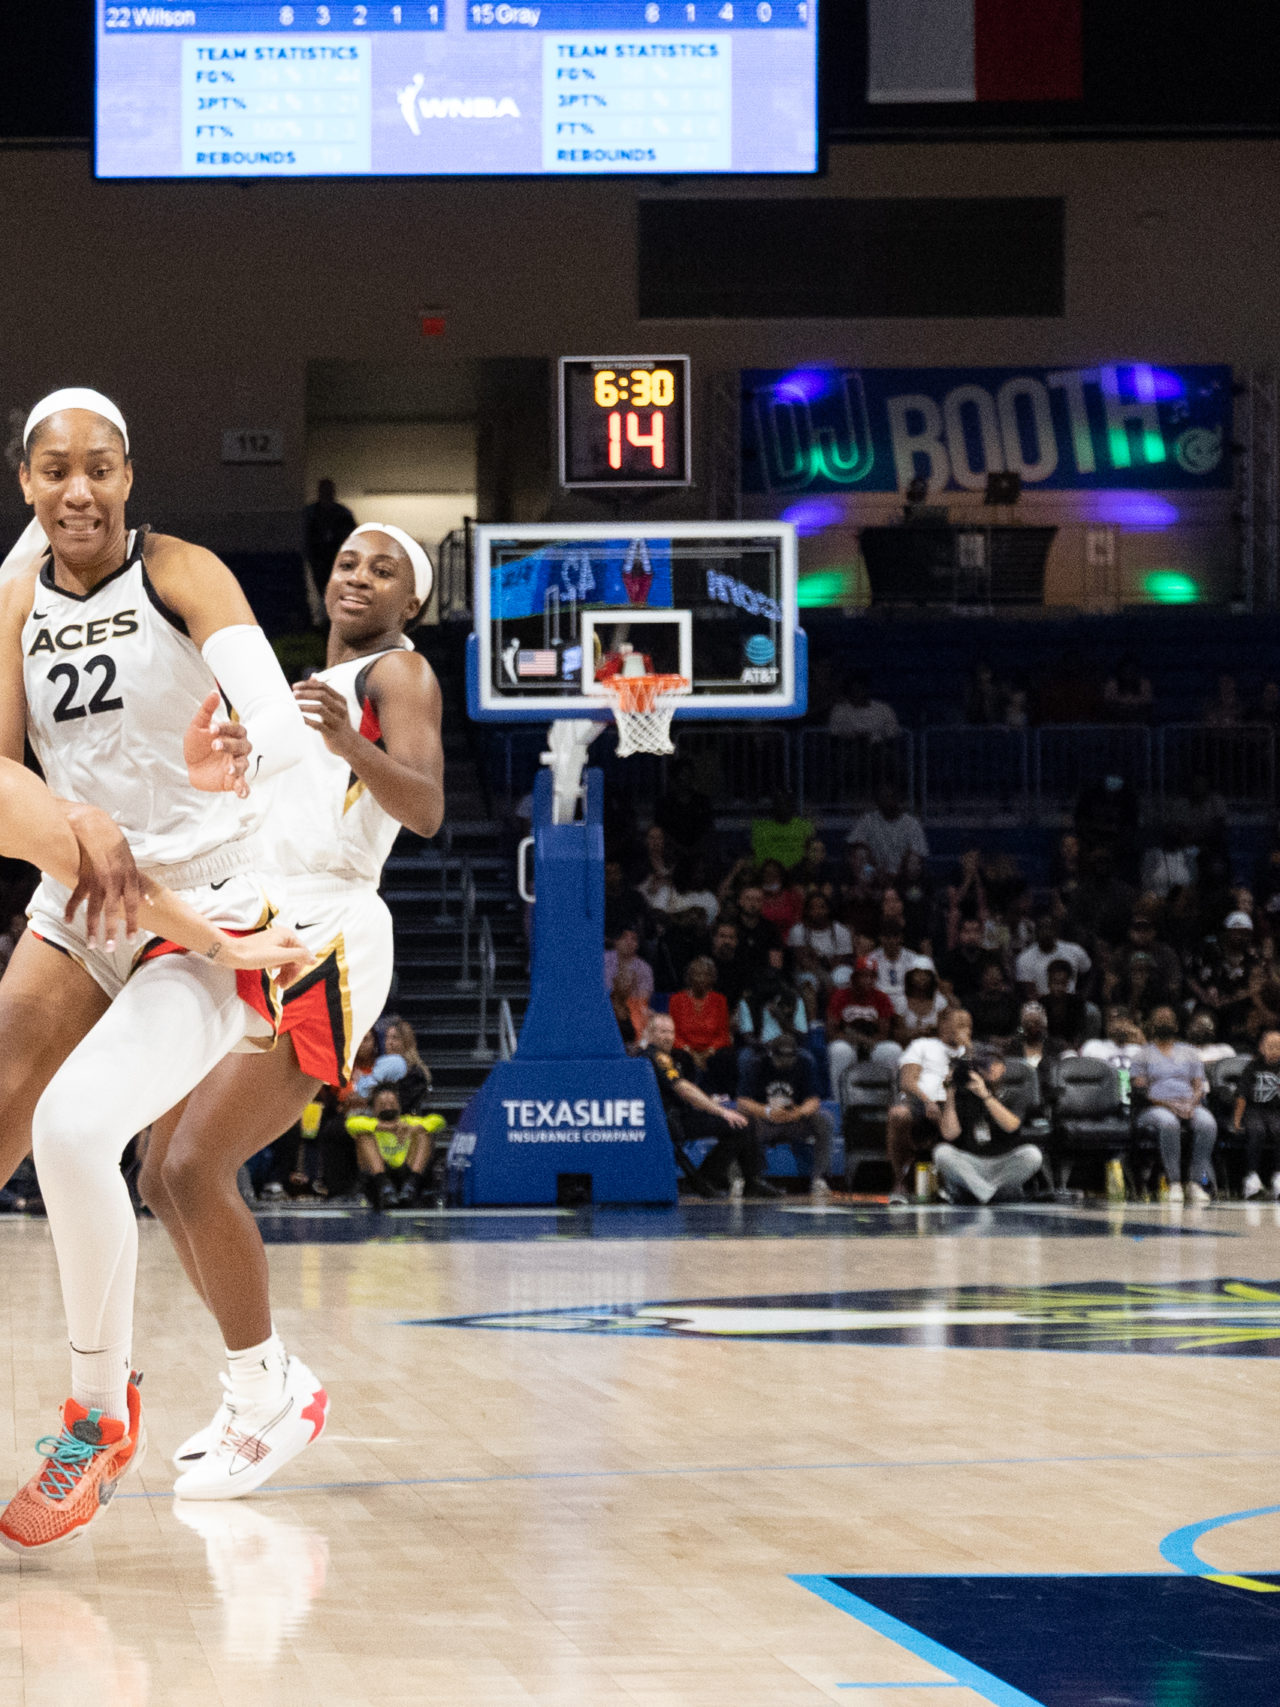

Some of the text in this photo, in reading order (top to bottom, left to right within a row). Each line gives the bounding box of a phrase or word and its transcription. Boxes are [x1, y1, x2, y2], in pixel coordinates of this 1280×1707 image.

[106, 7, 131, 28] 22
[132, 7, 196, 27] Wilson
[316, 5, 331, 26] 3
[353, 5, 368, 26] 2
[391, 5, 402, 25] 1
[428, 5, 438, 25] 1
[471, 4, 494, 24] 15
[495, 3, 541, 27] Gray
[686, 3, 696, 22] 1
[718, 2, 734, 21] 4
[757, 2, 772, 22] 0
[797, 2, 807, 22] 1
[196, 47, 359, 60] TEAM STATISTICS
[557, 44, 719, 58] TEAM STATISTICS
[196, 70, 235, 83] FG%
[557, 67, 596, 80] FG%
[419, 96, 521, 119] WNBA
[196, 125, 234, 137] FT%
[557, 122, 595, 134] FT%
[196, 151, 296, 164] REBOUNDS
[557, 149, 656, 161] REBOUNDS
[594, 369, 675, 407] 6:30
[608, 410, 665, 470] 14
[886, 361, 1166, 502] BOOTH
[237, 434, 270, 453] 112
[28, 609, 139, 657] ACES
[740, 667, 779, 684] AT&T
[46, 654, 124, 723] 22
[502, 1099, 645, 1127] TEXASLIFE
[508, 1130, 646, 1143] INSURANCE COMPANY
